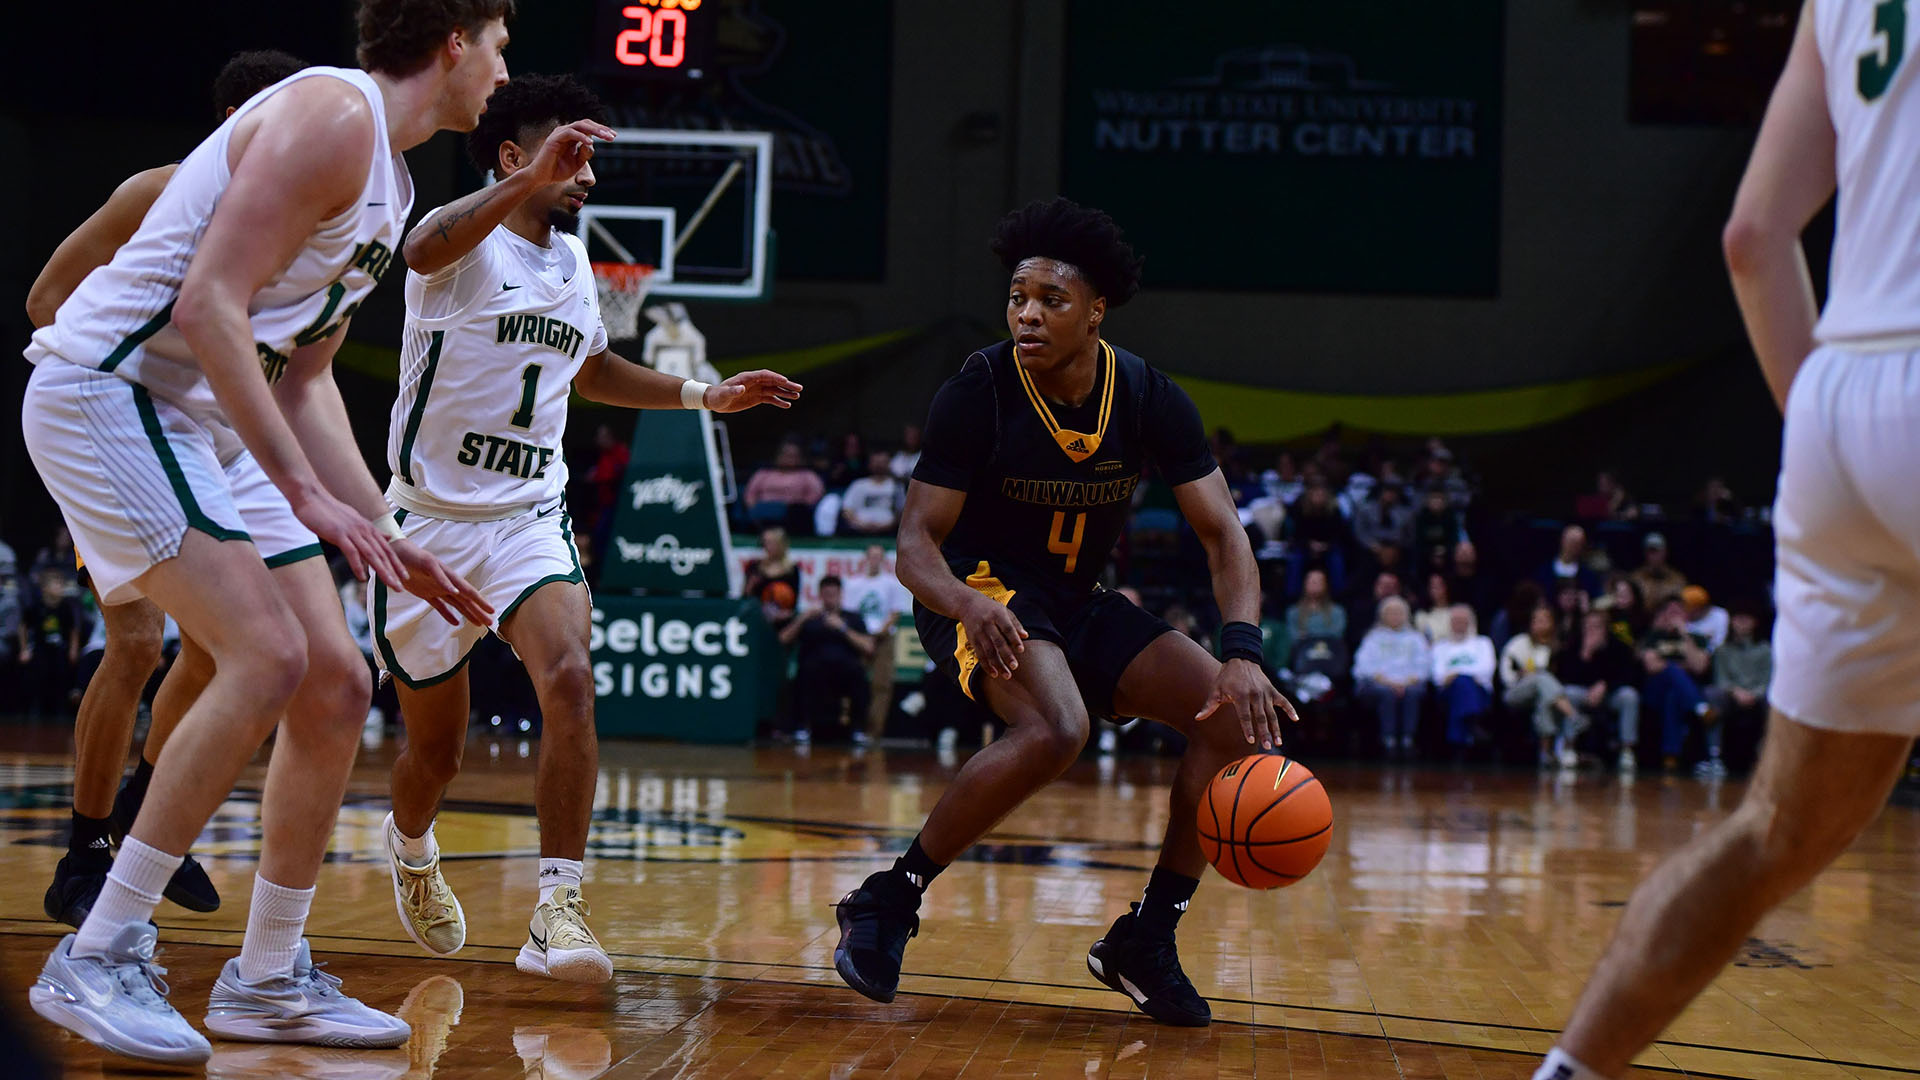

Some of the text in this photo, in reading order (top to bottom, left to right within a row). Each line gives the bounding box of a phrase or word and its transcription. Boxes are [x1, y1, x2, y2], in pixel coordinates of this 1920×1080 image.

[615, 6, 687, 68] 20
[1095, 120, 1476, 158] NUTTER CENTER
[496, 315, 585, 360] WRIGHT
[510, 364, 543, 430] 1
[457, 431, 554, 480] STATE
[1047, 510, 1088, 574] 4
[590, 608, 750, 658] Select
[592, 660, 734, 701] SIGNS
